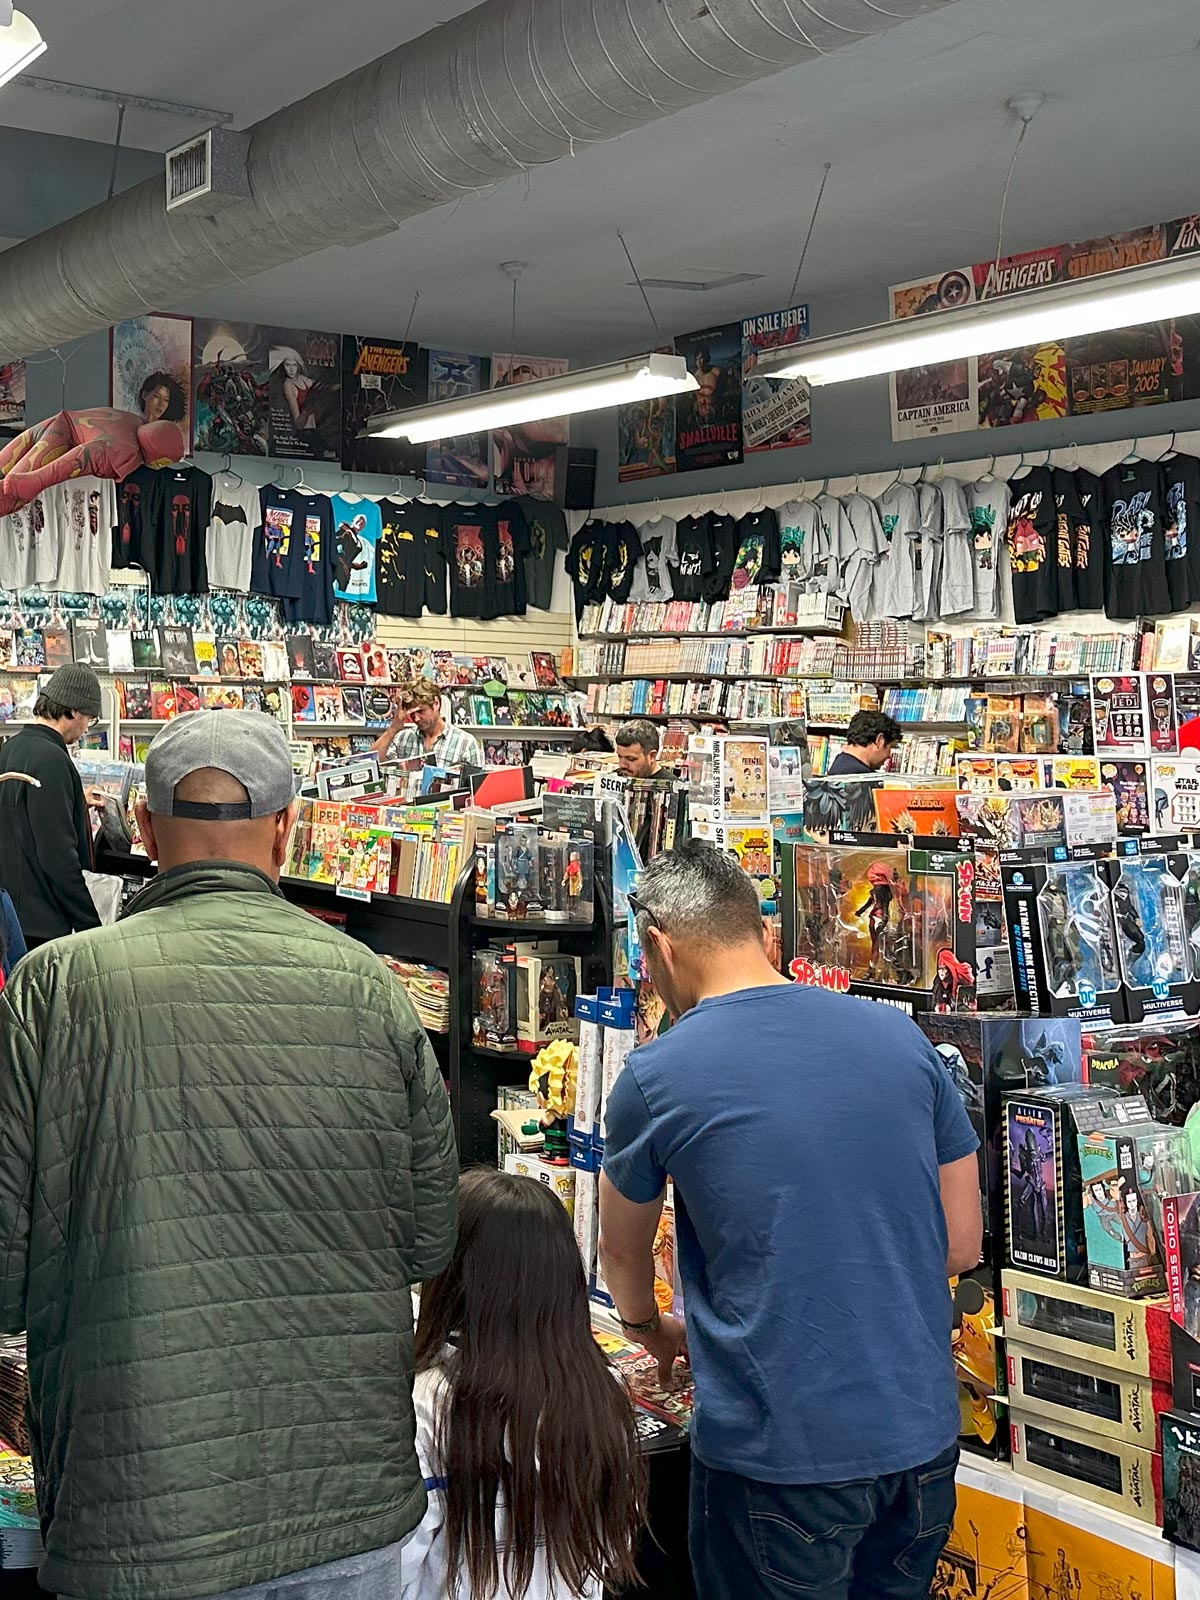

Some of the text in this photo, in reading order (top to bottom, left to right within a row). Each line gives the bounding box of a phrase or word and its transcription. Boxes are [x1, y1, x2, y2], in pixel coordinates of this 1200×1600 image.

[981, 259, 1055, 300] AVENGERS
[743, 307, 806, 336] ON SALE HERE!
[353, 346, 410, 375] AVENGERS
[1129, 357, 1166, 376] JANUARY
[1134, 374, 1160, 392] 2005
[897, 402, 970, 422] CAPTAIN AMERICA
[679, 424, 737, 449] SMALLVILLE
[1113, 699, 1139, 708] JEDI
[712, 741, 721, 806] MIRAJANE STRAUSS
[320, 810, 339, 822] PEP
[349, 813, 373, 826] PEP
[957, 860, 974, 923] SPAWN
[1018, 901, 1031, 938] BATMAN
[1015, 937, 1026, 964] FUTURE
[1023, 942, 1033, 964] DARK
[789, 957, 850, 992] SPAWN
[1020, 965, 1028, 993] STATE
[1080, 991, 1095, 1004] DC
[1153, 982, 1168, 996] DC
[1068, 1008, 1111, 1018] MULTIVERSE
[1143, 999, 1183, 1010] MULTIVERSE
[1091, 1058, 1119, 1070] DRACULA
[1018, 1107, 1043, 1118] ALIEN
[1165, 1203, 1182, 1314] TOHO SERIES
[1132, 1279, 1160, 1292] TURTLES
[1126, 1310, 1134, 1360] AVATAR
[1132, 1383, 1140, 1433] AVATAR
[1132, 1458, 1142, 1508] AVATAR
